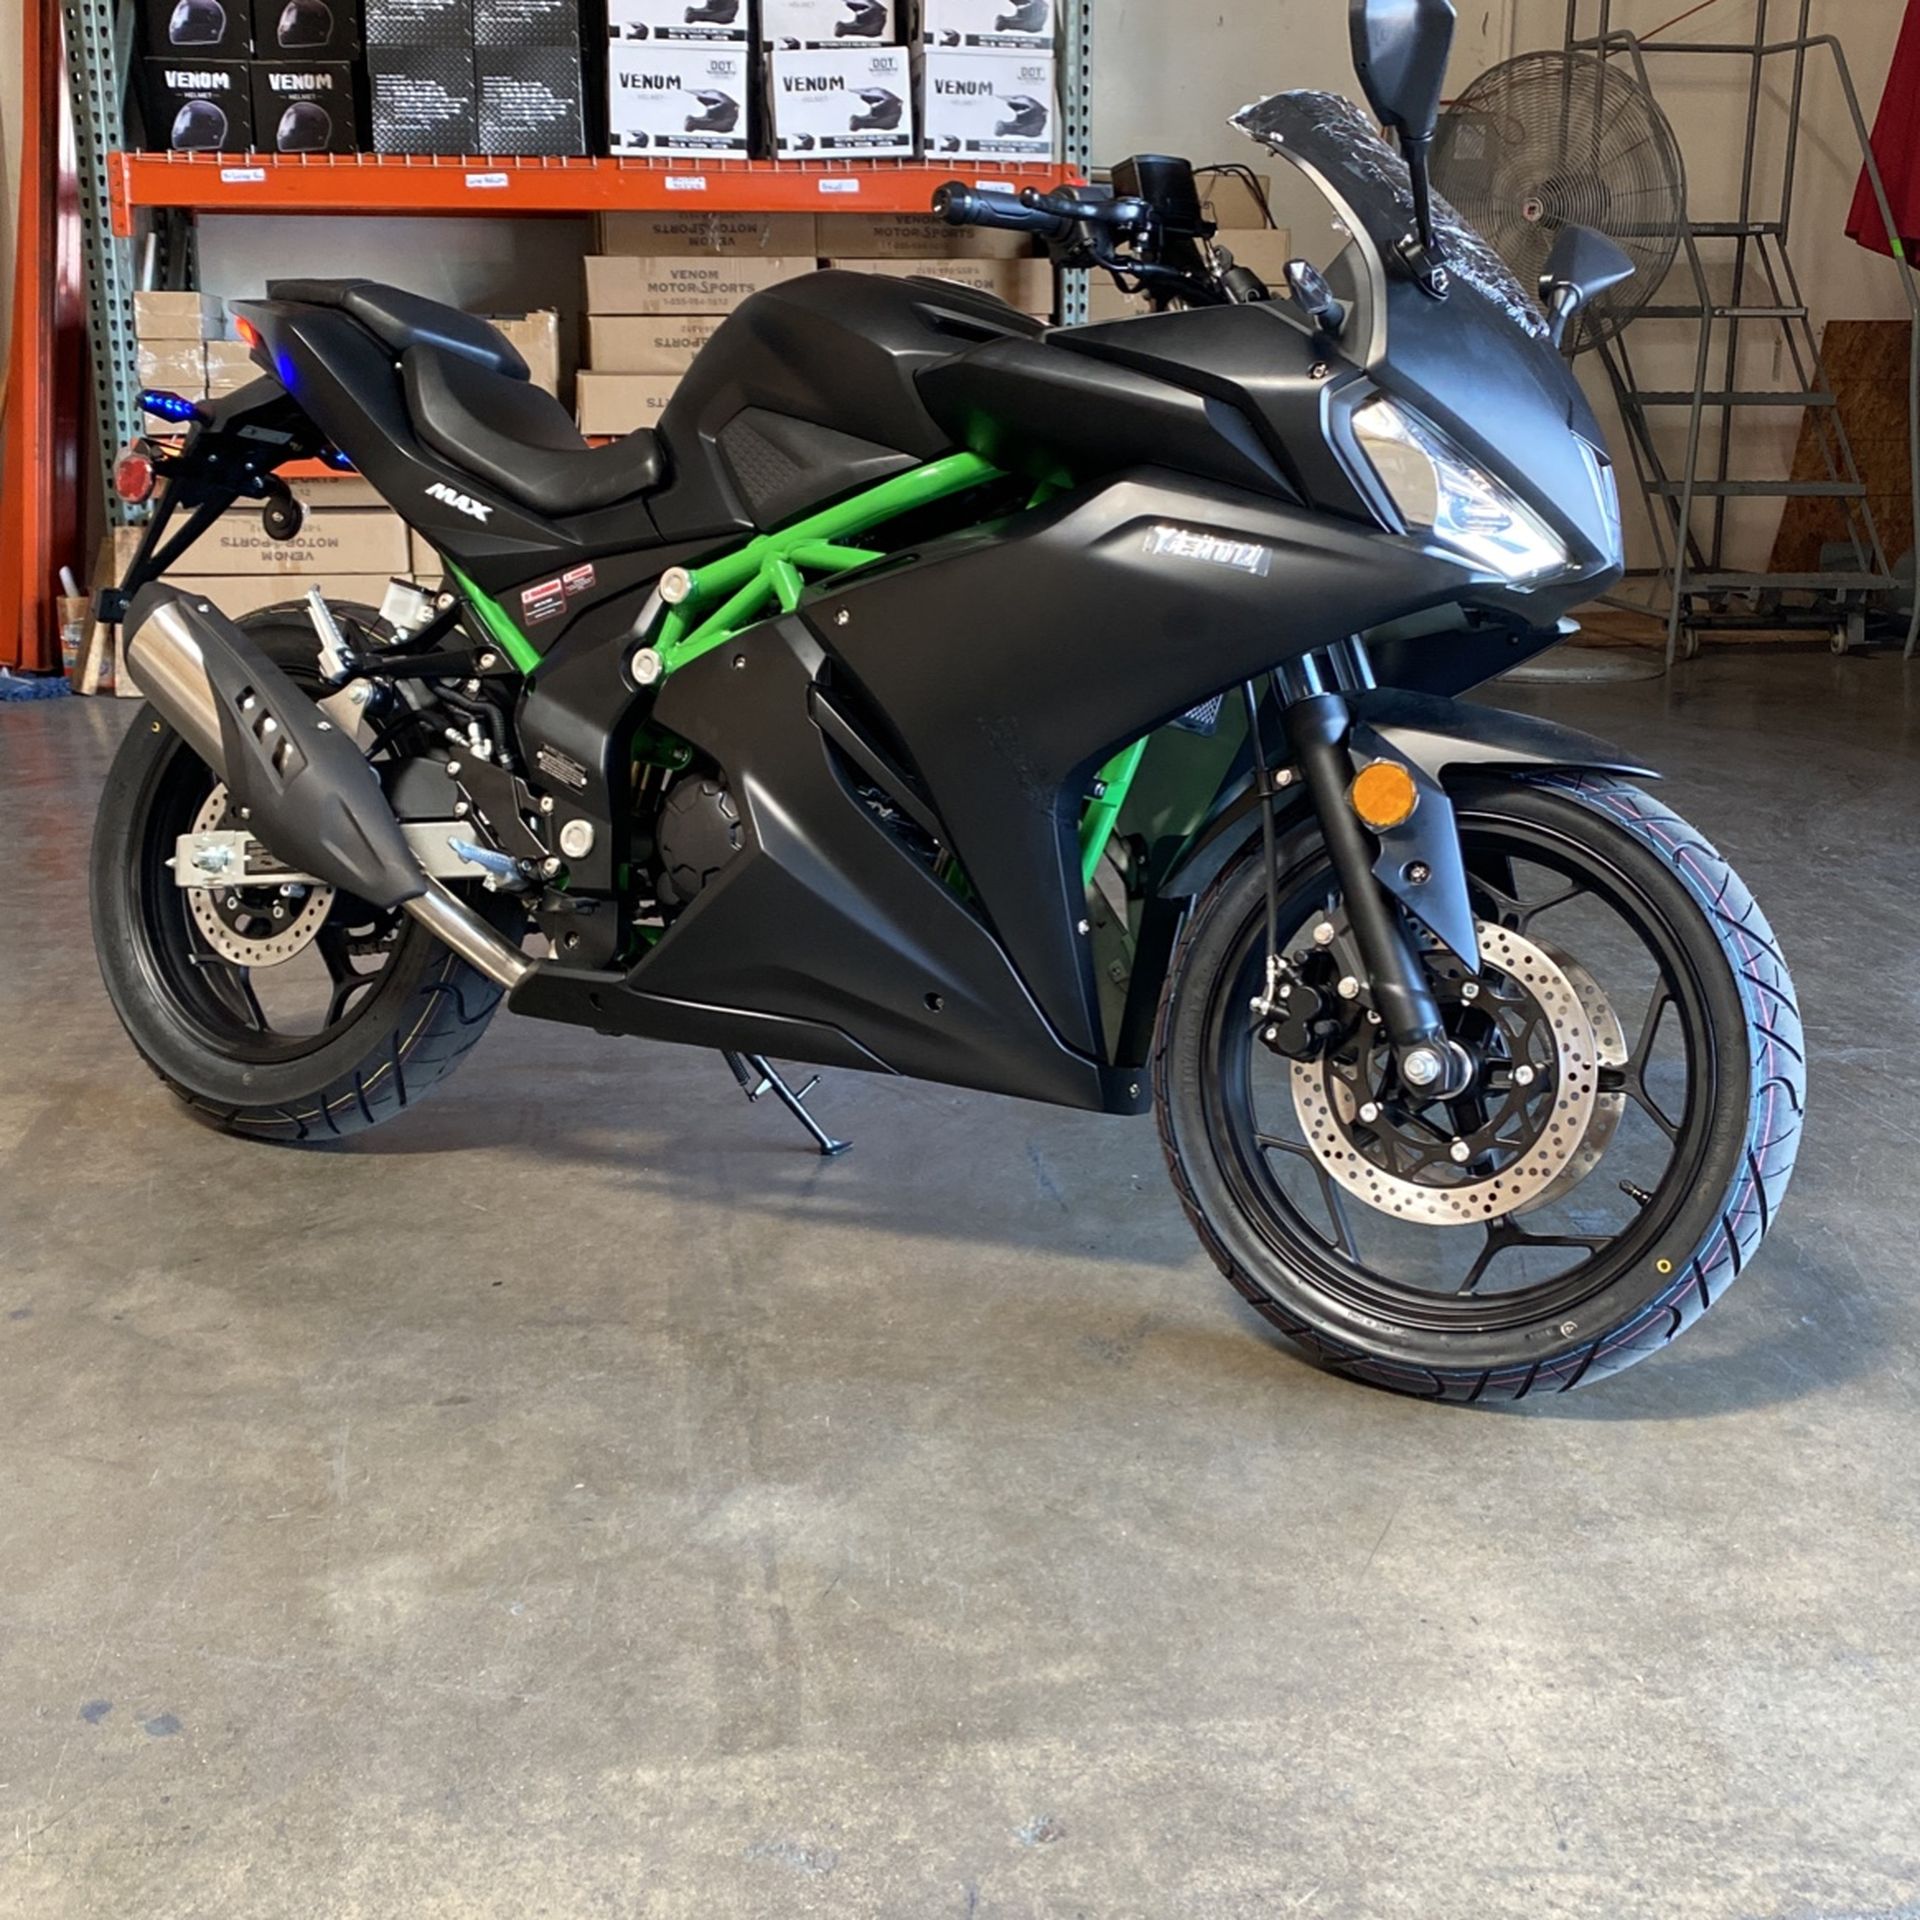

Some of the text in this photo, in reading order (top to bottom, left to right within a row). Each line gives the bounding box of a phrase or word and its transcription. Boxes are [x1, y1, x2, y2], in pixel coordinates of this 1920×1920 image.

[710, 60, 733, 71] DOT
[871, 57, 894, 68] DOT
[1020, 66, 1043, 77] DOT
[164, 70, 231, 90] VENOM
[268, 73, 333, 91] VENOM
[689, 237, 736, 246] VEOM
[670, 270, 719, 280] VENOM
[424, 482, 494, 525] MAX
[261, 552, 314, 561] VENOM
